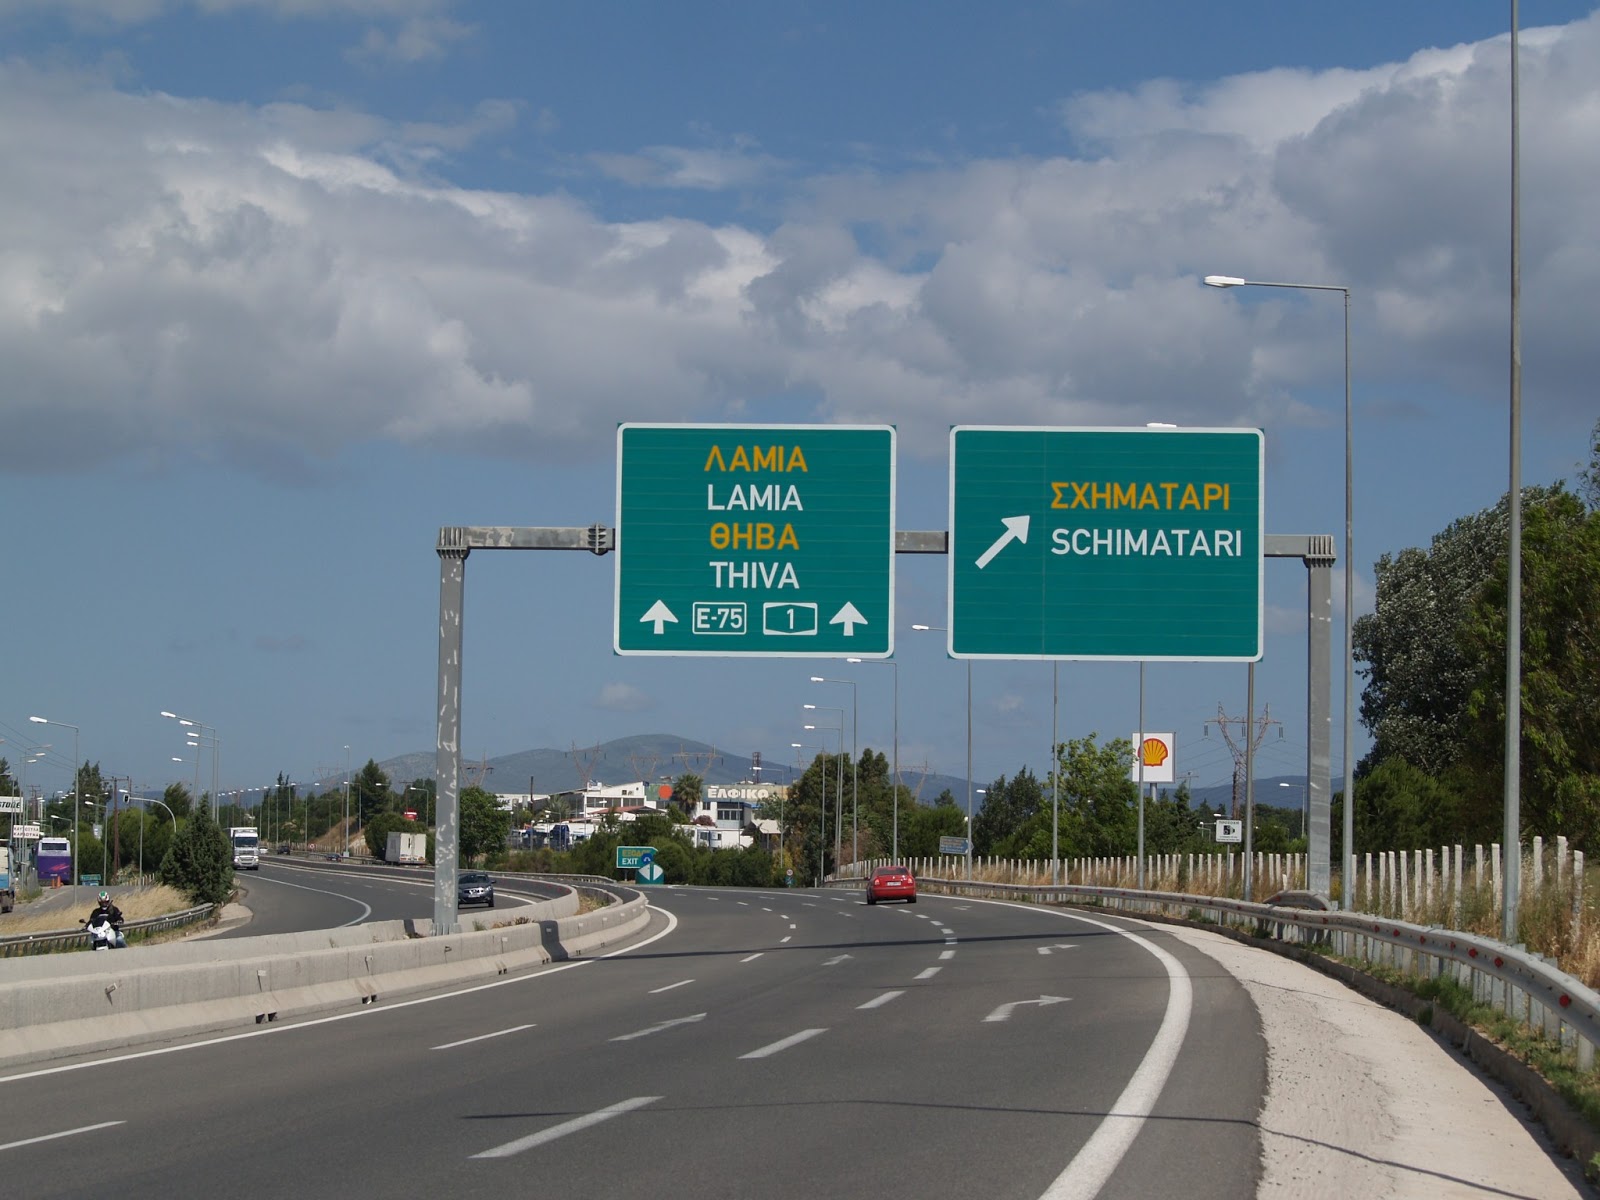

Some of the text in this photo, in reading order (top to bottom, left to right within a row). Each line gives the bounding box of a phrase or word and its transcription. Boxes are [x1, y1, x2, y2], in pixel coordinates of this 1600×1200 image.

[704, 445, 808, 472] ΛΑΜΙΑ
[707, 484, 803, 511] LAMIA
[1050, 481, 1230, 511] ΣΧΗΜΑΤΑΡΙ
[710, 522, 800, 550] ΘΗΒΑ
[1050, 528, 1242, 557] SCHIMATARI
[709, 561, 800, 589] THIVA
[696, 608, 743, 629] E-75
[786, 608, 795, 630] 1
[621, 857, 639, 865] EXIT
